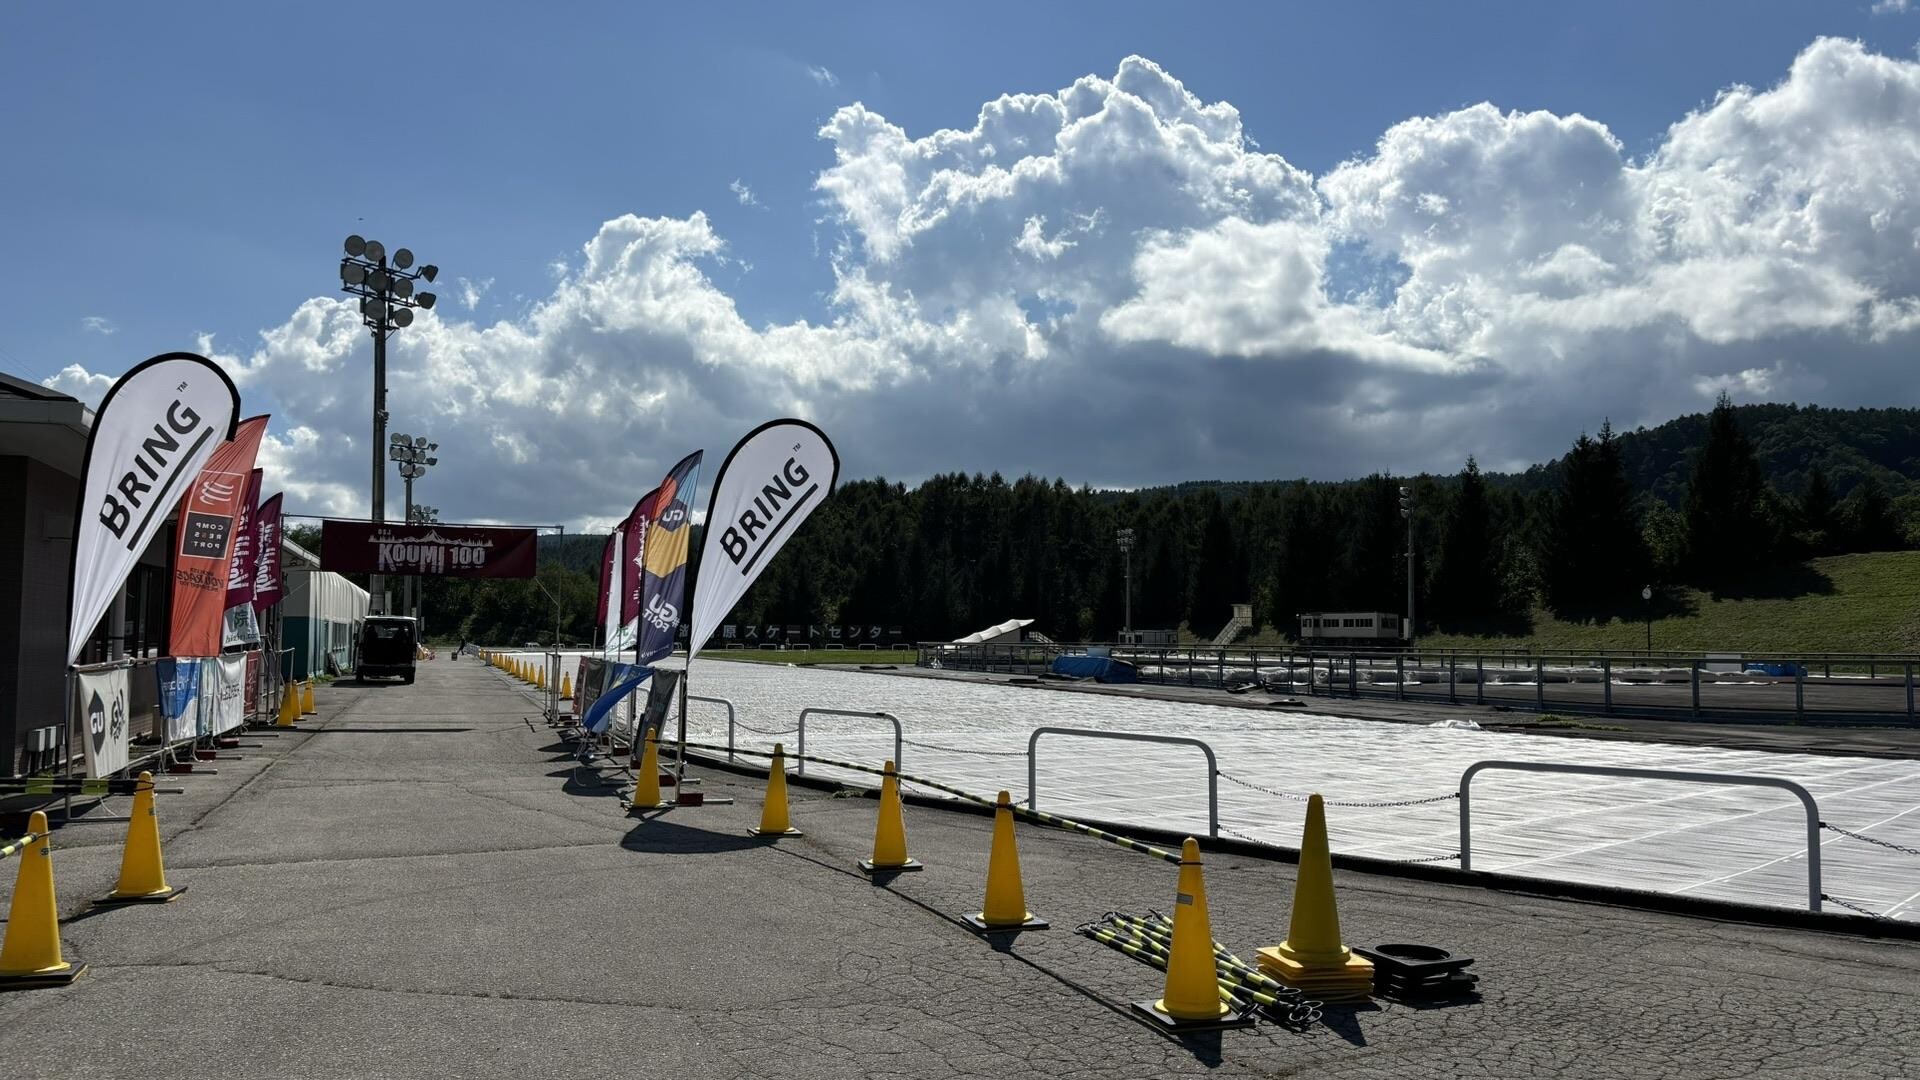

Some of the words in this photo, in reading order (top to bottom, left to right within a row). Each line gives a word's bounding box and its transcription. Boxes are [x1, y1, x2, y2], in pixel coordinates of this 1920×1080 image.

[100, 400, 201, 540] BRING
[720, 457, 810, 566] BRING
[378, 543, 445, 574] KOUMI
[450, 547, 486, 569] 100
[90, 712, 104, 734] GU
